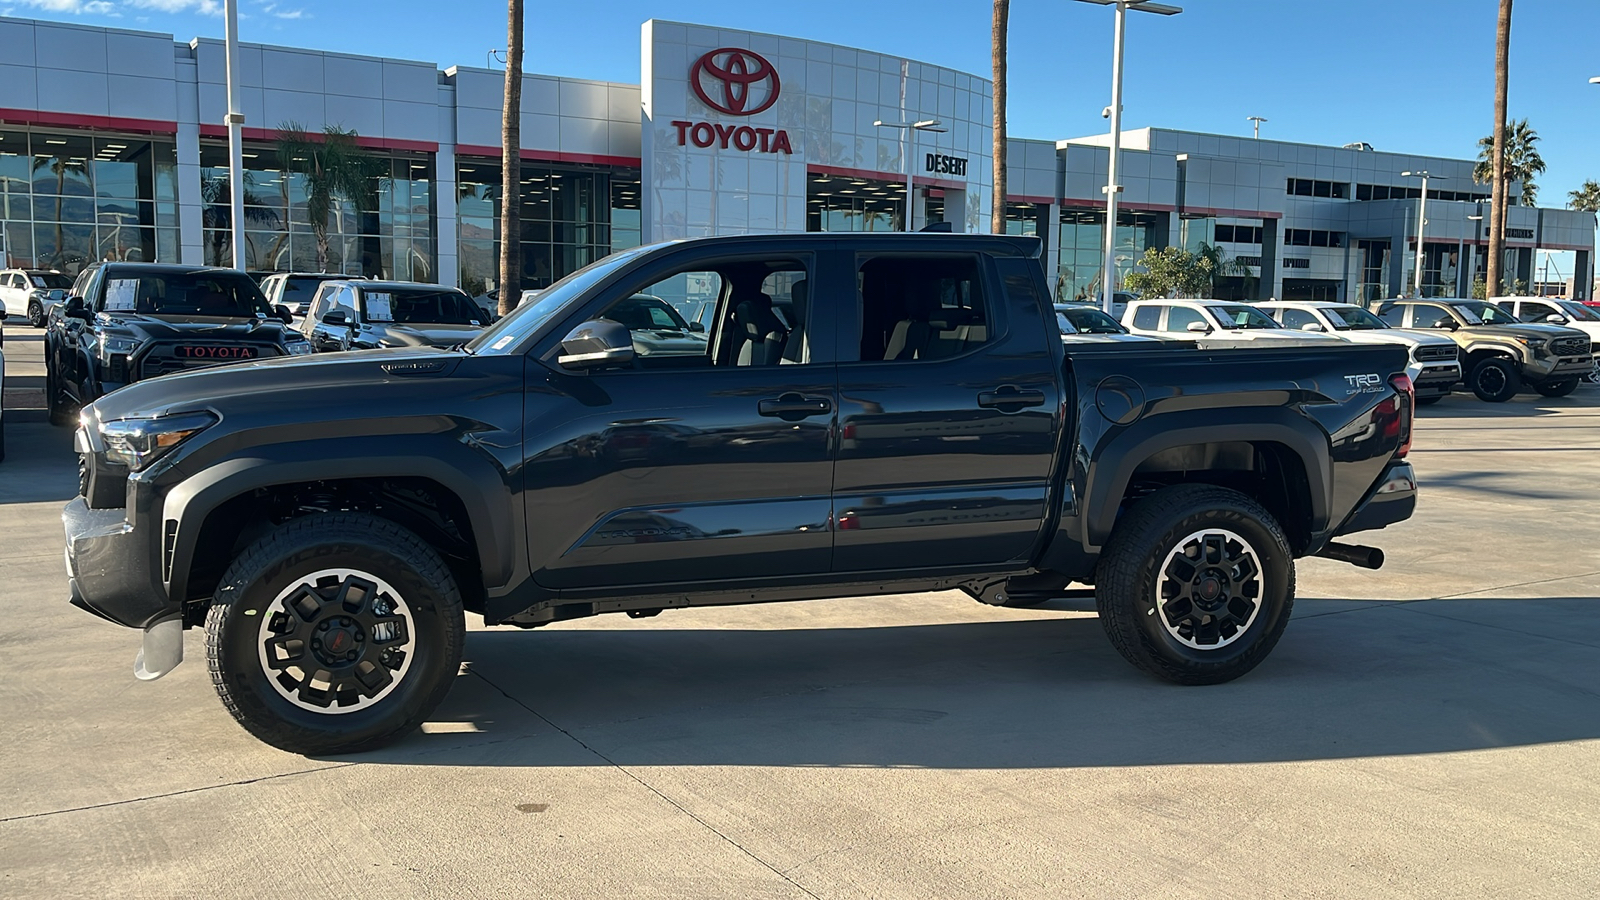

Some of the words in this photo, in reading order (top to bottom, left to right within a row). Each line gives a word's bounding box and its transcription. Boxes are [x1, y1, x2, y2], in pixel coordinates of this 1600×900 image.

[671, 120, 793, 154] TOYOTA
[926, 153, 968, 176] DESERT
[183, 346, 251, 358] TOYOTA
[1343, 373, 1381, 388] TRD
[595, 526, 692, 539] TACOMA
